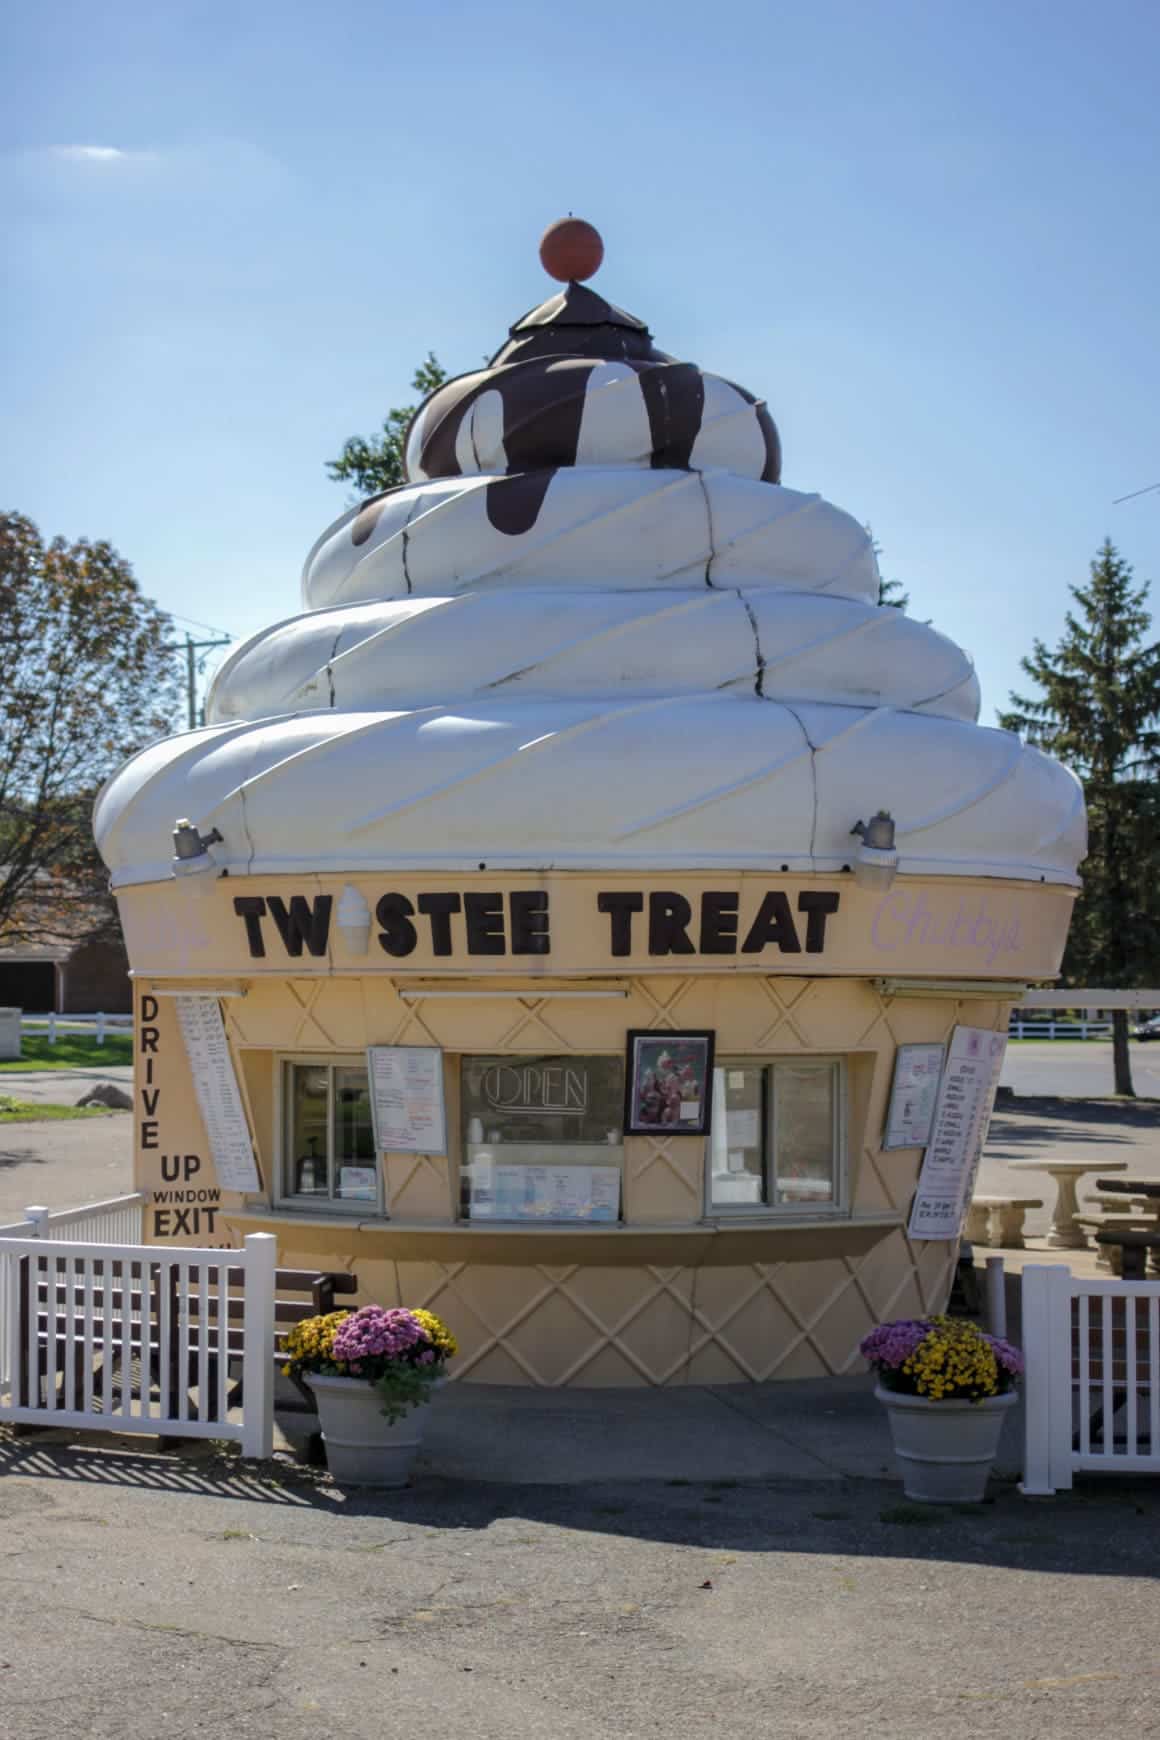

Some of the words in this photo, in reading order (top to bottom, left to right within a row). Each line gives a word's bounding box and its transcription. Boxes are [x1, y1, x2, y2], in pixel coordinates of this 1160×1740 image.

[597, 891, 841, 957] TREAT
[140, 994, 161, 1150] DRIVE
[482, 1065, 589, 1116] OPEN
[160, 1154, 202, 1182] UP
[153, 1187, 221, 1204] WINDOW
[153, 1206, 220, 1236] EXIT
